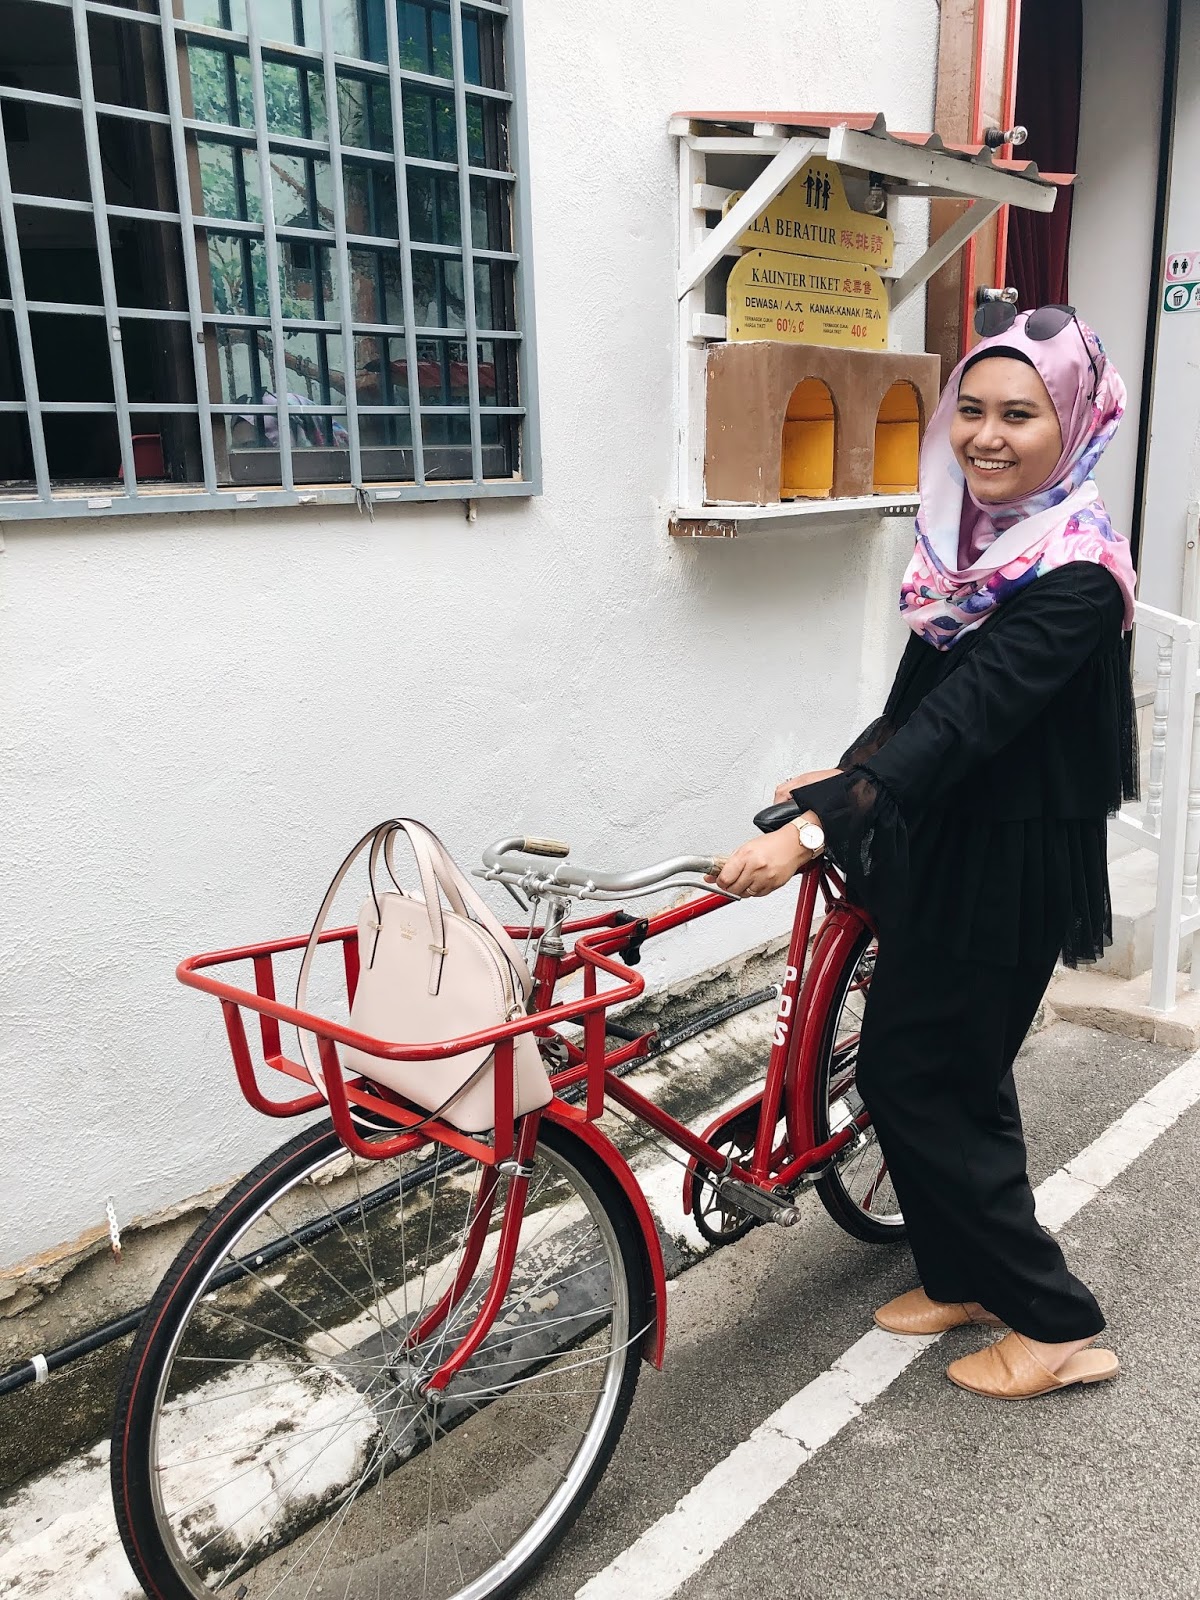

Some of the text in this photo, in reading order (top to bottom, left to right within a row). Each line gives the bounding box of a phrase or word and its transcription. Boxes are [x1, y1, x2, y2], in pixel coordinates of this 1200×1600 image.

[776, 218, 836, 245] BERATUR
[752, 268, 840, 292] KAUNTER TIKET
[745, 297, 778, 309] DEWASA
[809, 303, 861, 318] KANAK-KANAK
[772, 965, 798, 1046] POS
